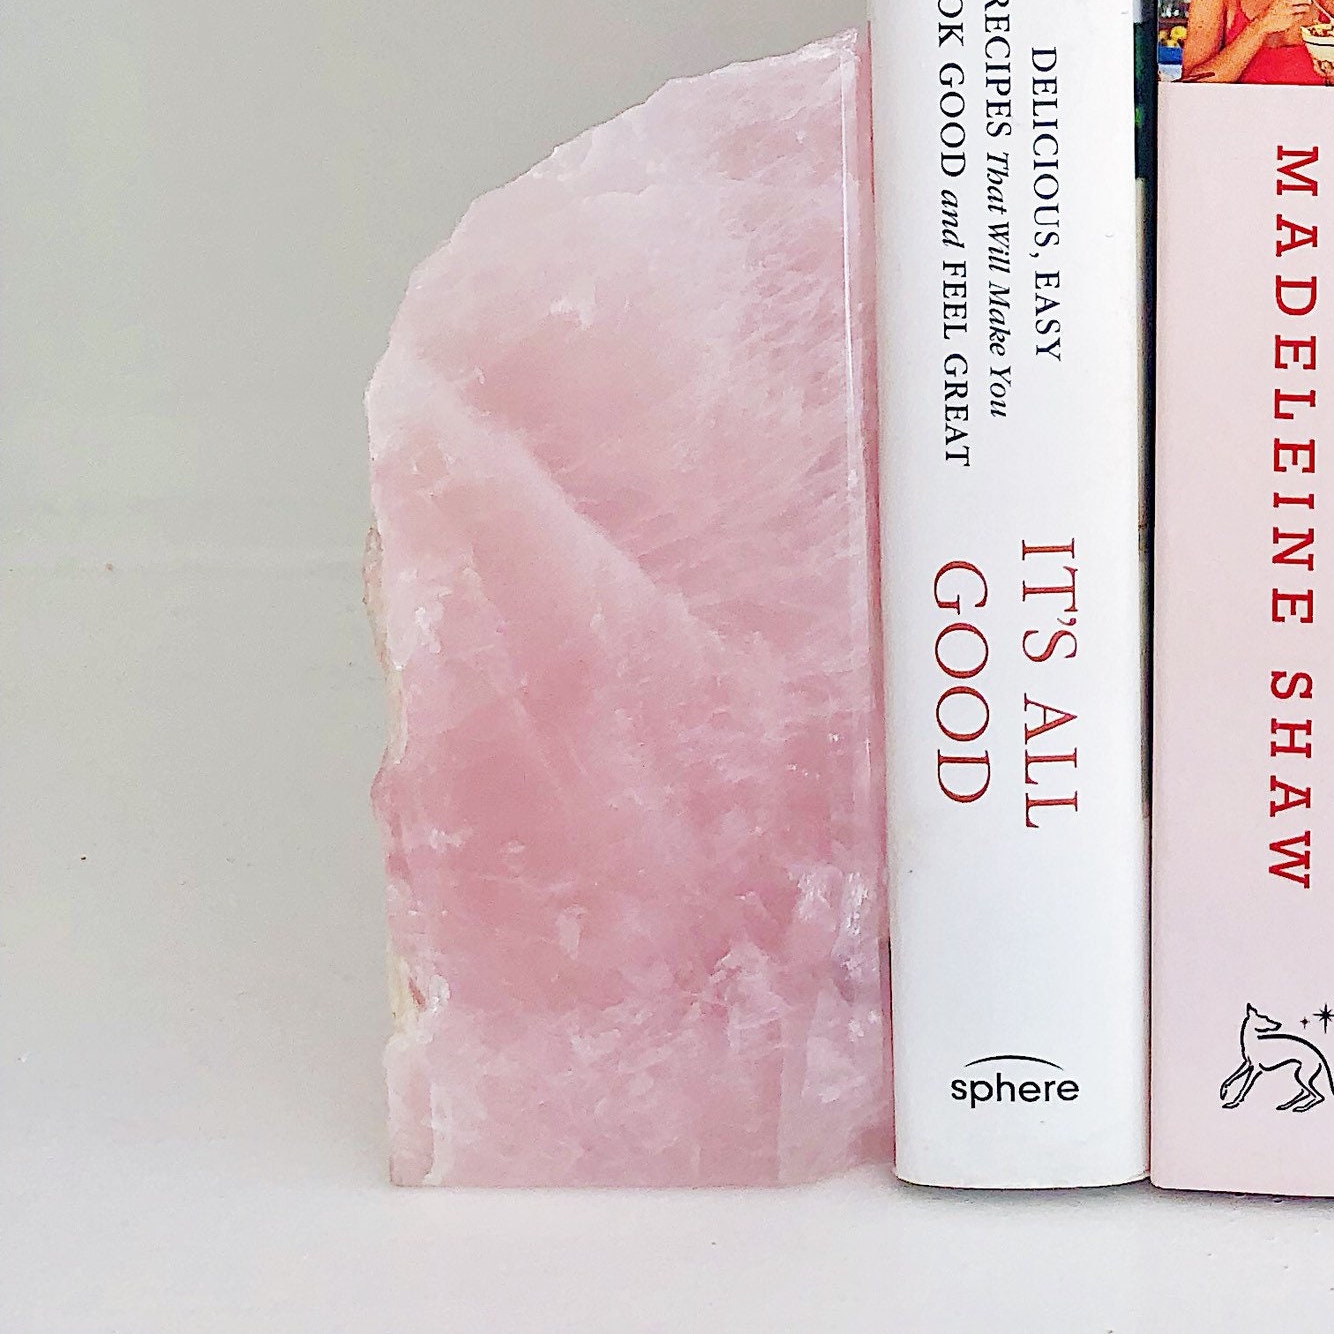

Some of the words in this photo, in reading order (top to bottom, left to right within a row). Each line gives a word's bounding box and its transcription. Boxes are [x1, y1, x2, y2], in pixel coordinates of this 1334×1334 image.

[938, 62, 967, 178] GOOD
[1028, 46, 1060, 259] DELICIOUS,
[940, 189, 966, 249] and
[986, 151, 1010, 214] That
[987, 221, 1011, 274] Will
[942, 260, 968, 340] FEEL
[988, 280, 1012, 357] Make
[1034, 270, 1062, 362] EASY
[943, 353, 971, 467] GREAT
[989, 365, 1012, 418] You
[1271, 144, 1319, 624] MADELEINE
[933, 560, 991, 804] GOOD
[1023, 692, 1079, 829] ALL
[1268, 670, 1314, 890] SHAW
[950, 1072, 1080, 1109] sphere
